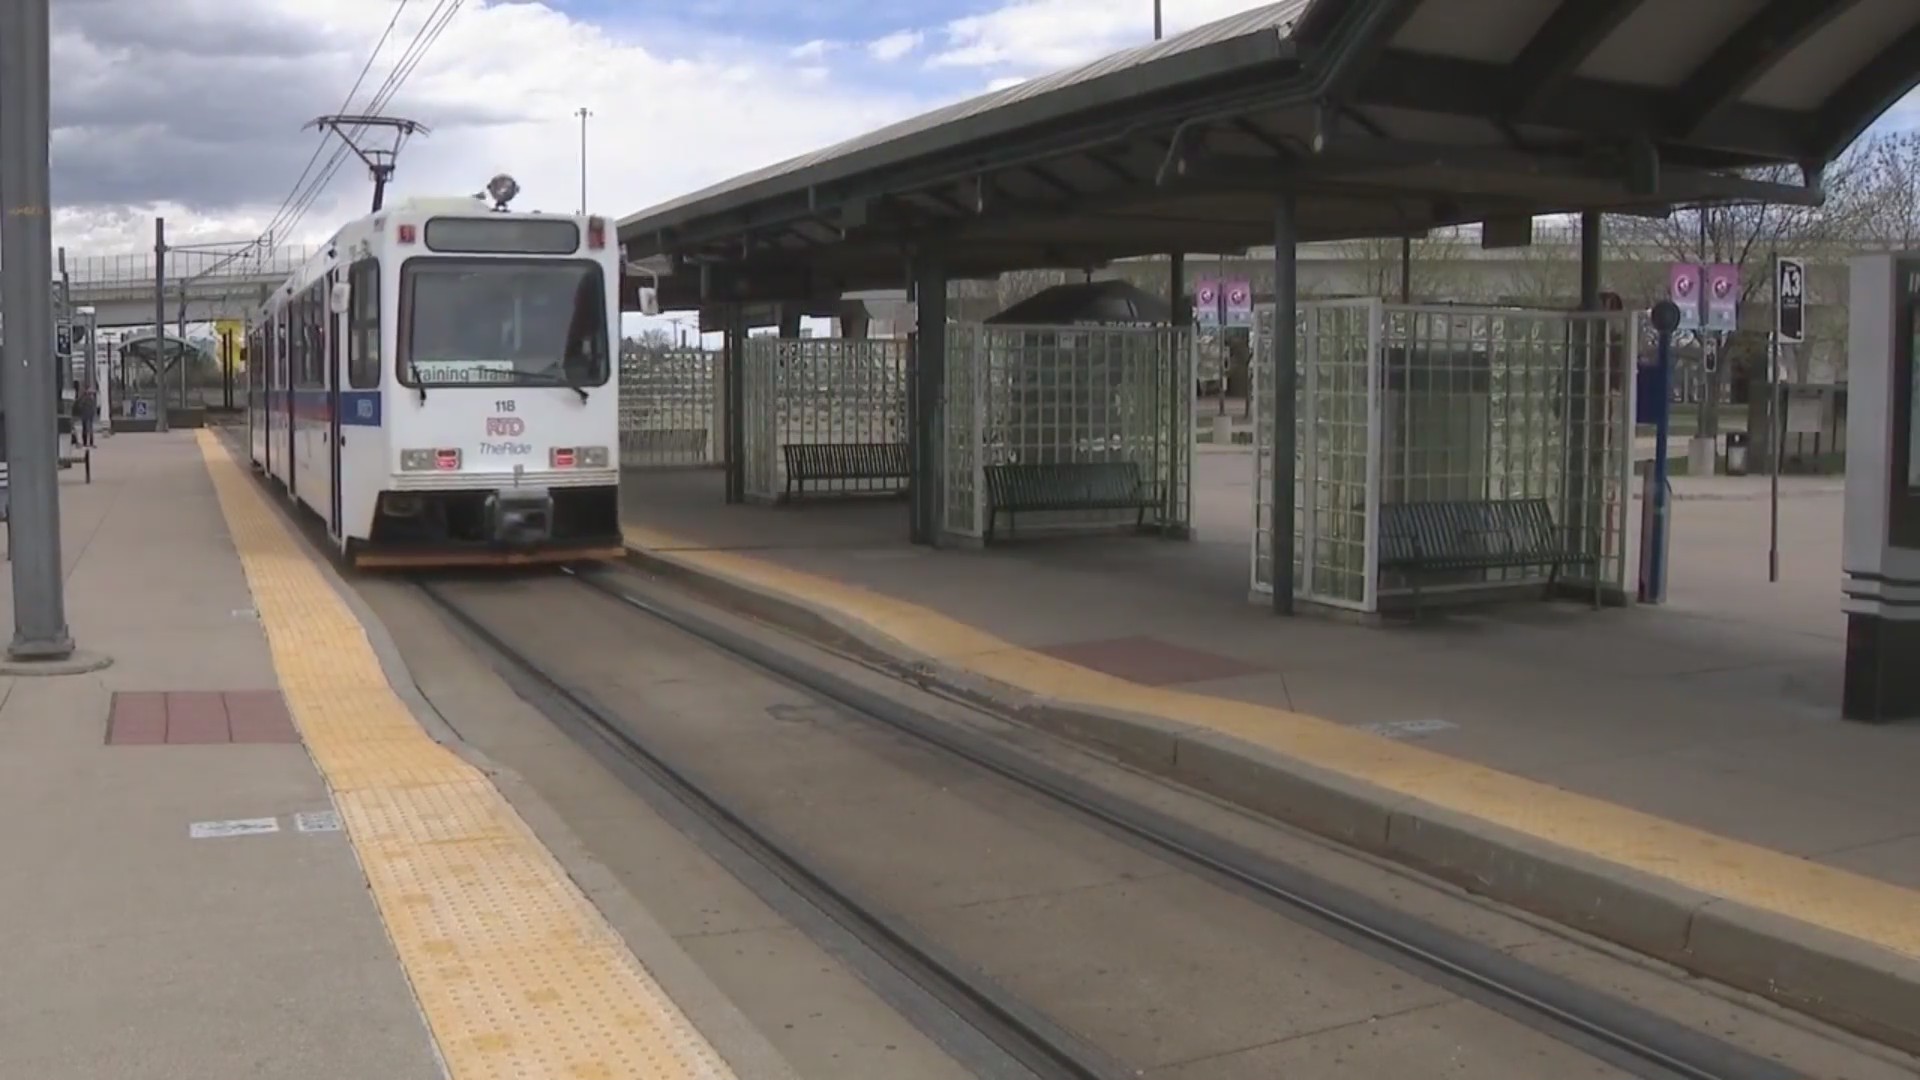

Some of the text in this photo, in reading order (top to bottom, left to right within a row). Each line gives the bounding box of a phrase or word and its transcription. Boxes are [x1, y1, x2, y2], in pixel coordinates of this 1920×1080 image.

[1782, 271, 1801, 297] A3
[495, 400, 516, 413] 118
[486, 417, 525, 437] RTD
